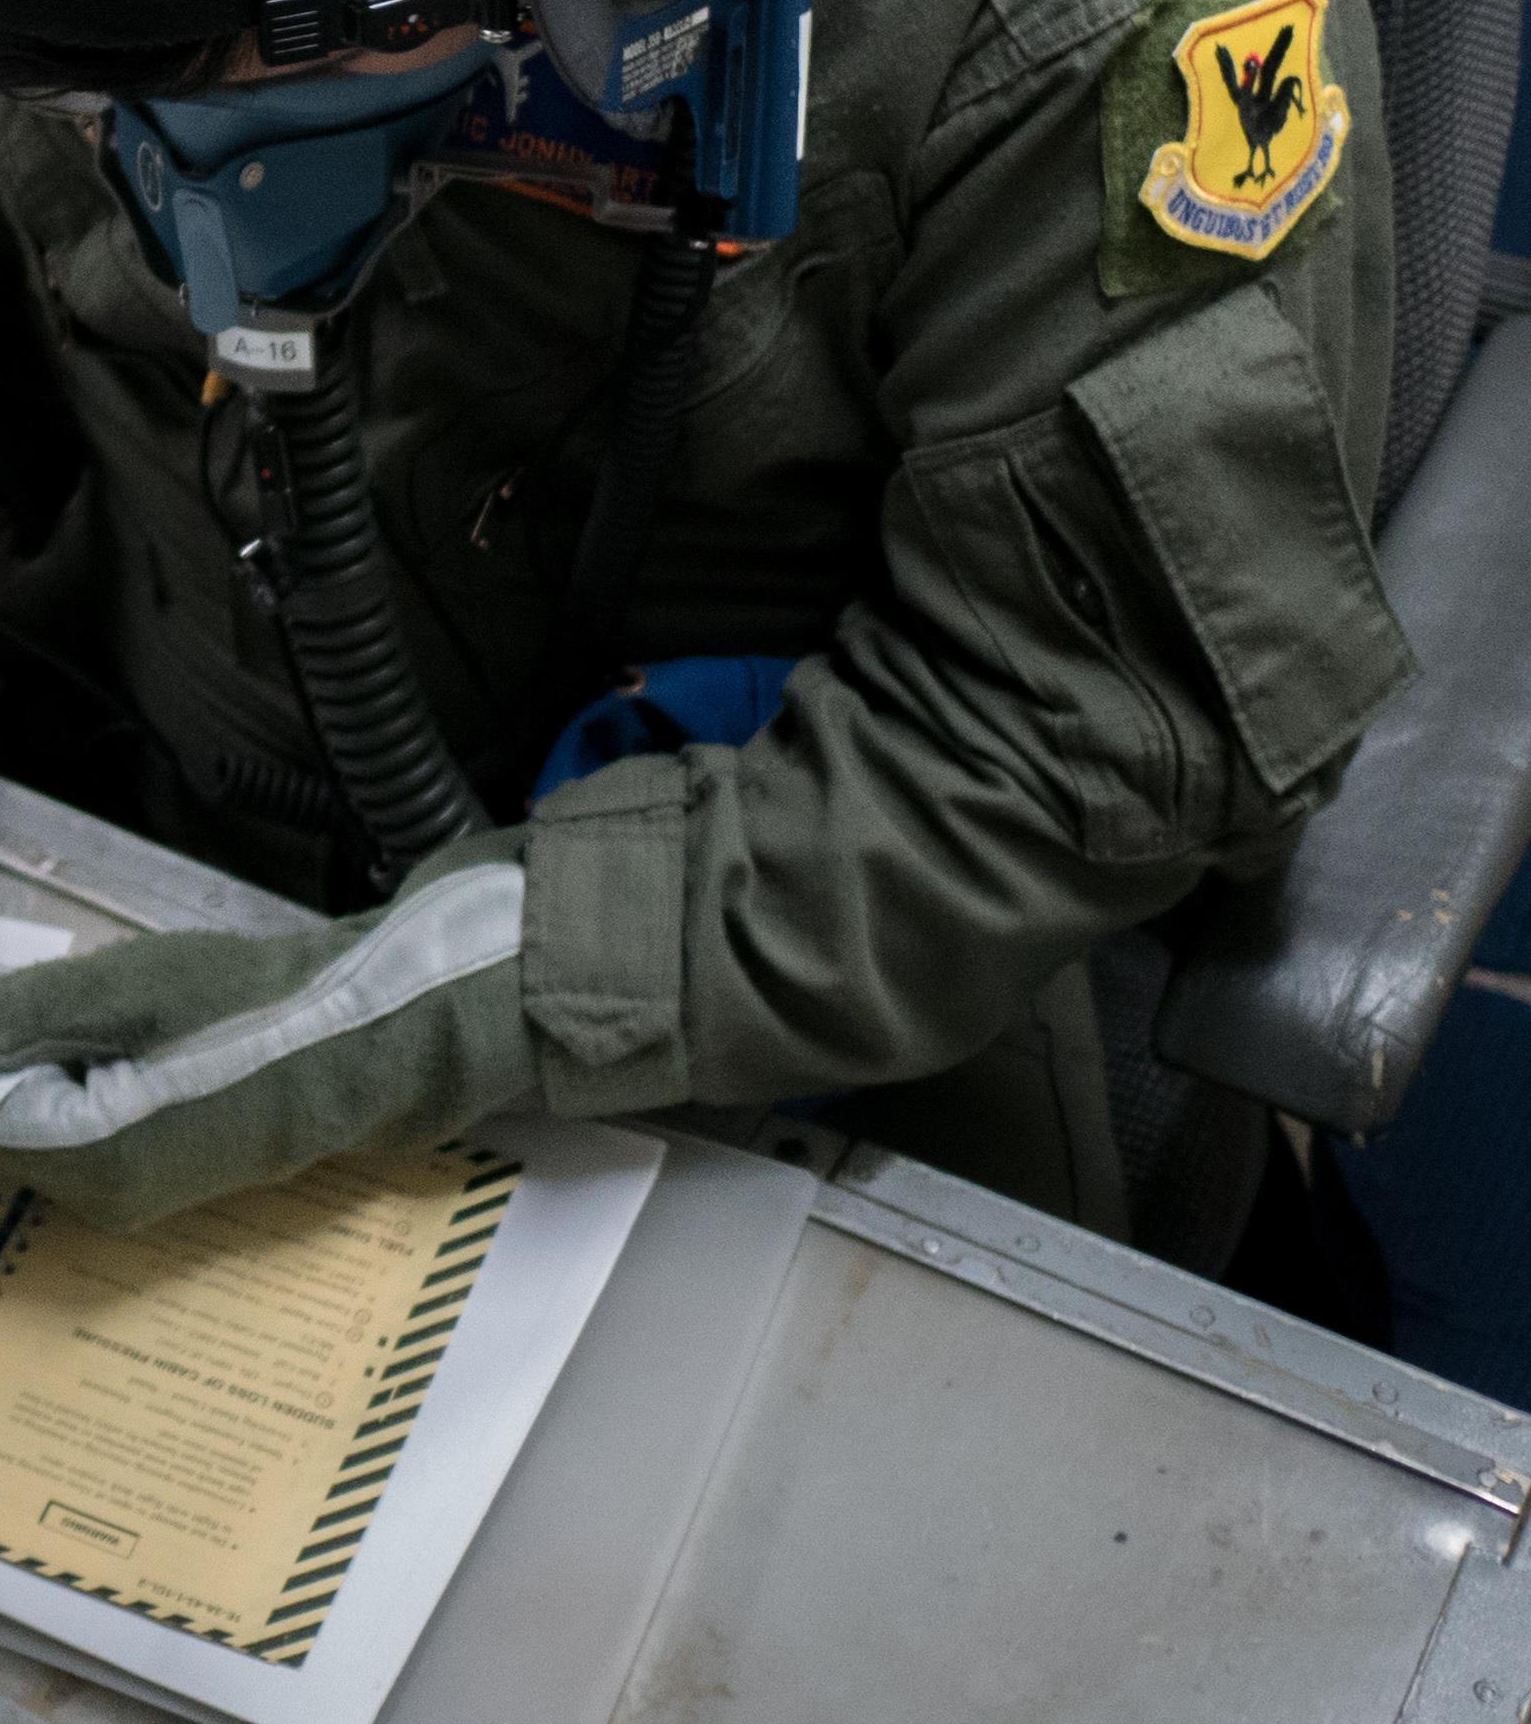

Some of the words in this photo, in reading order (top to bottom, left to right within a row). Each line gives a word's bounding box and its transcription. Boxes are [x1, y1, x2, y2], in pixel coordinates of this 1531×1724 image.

[71, 1326, 150, 1365] PRESSURE
[151, 1355, 200, 1382] CABIN
[201, 1373, 225, 1392] OF
[226, 1382, 269, 1407] LOSS
[271, 1398, 336, 1432] SUDDEN
[58, 1514, 121, 1547] WARNING
